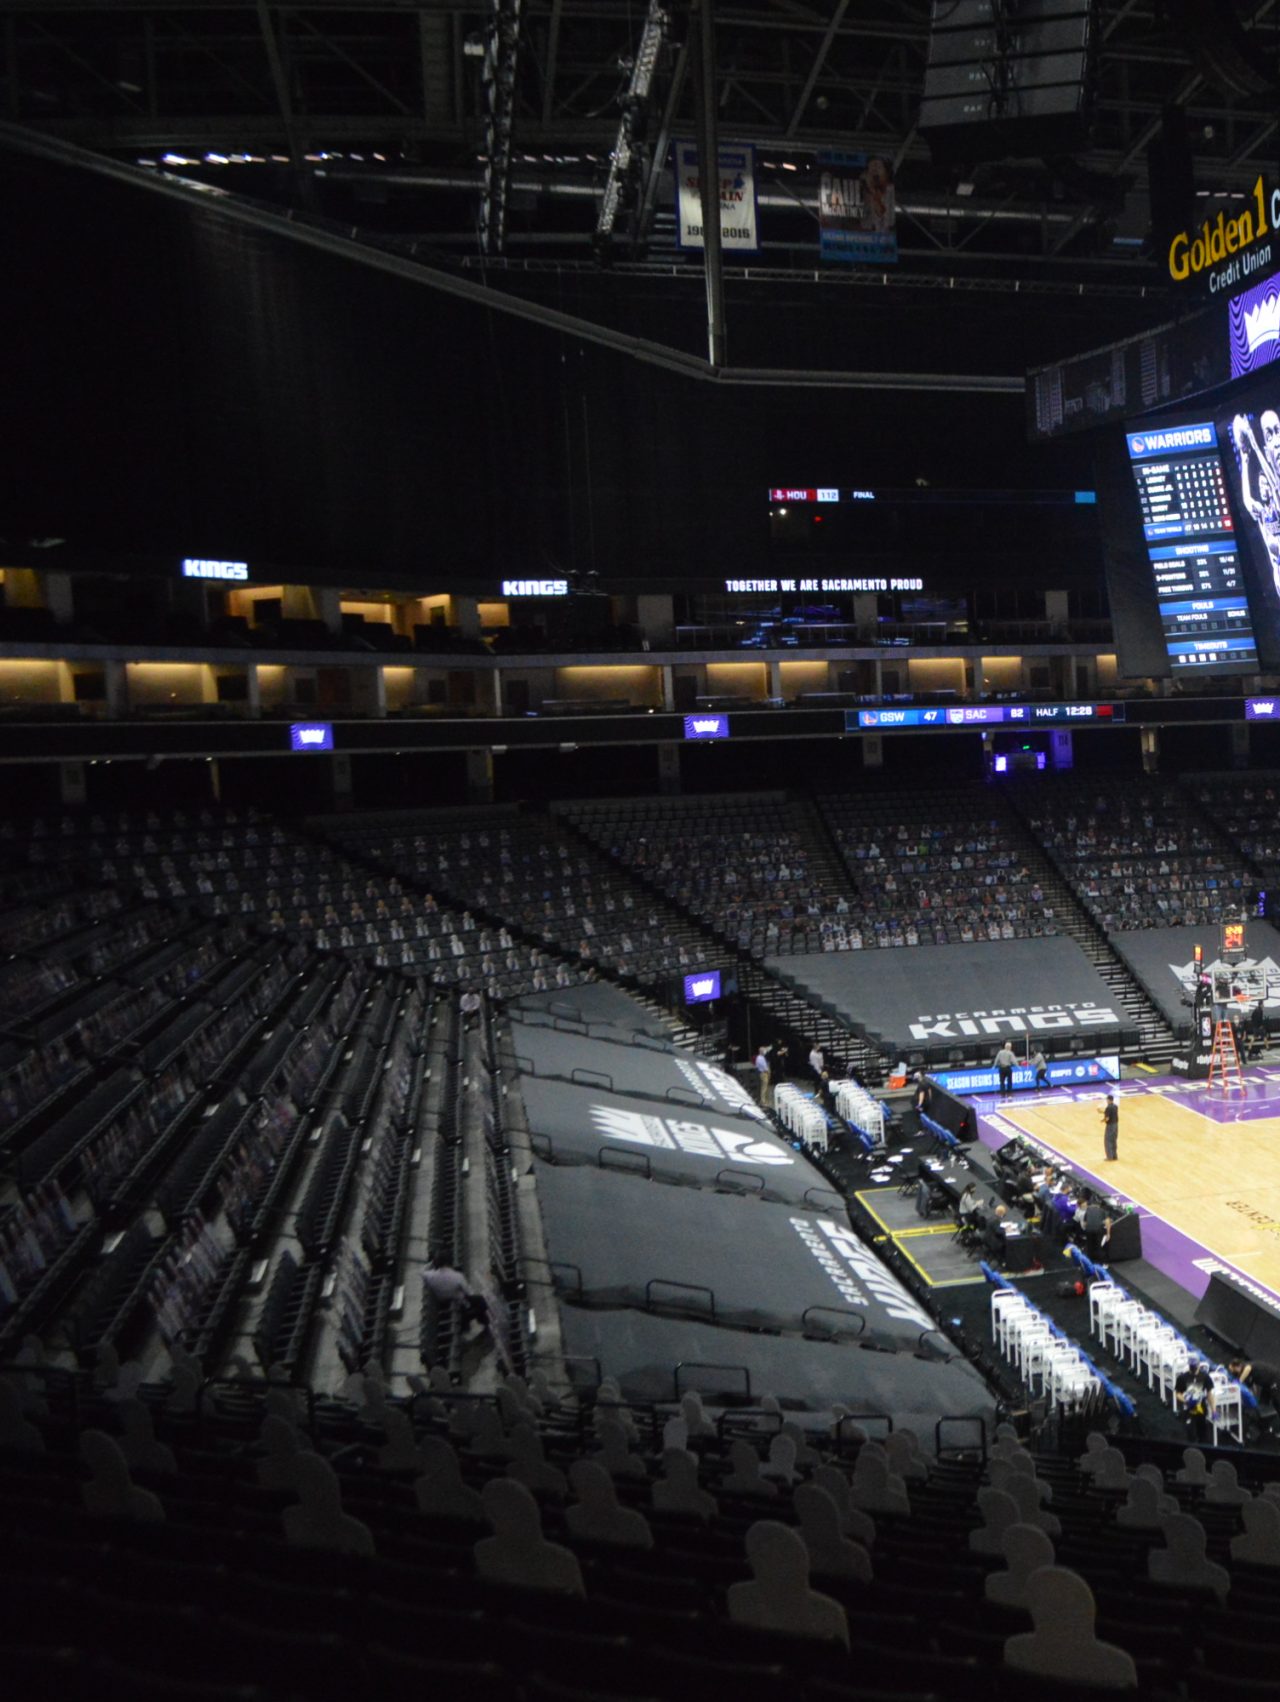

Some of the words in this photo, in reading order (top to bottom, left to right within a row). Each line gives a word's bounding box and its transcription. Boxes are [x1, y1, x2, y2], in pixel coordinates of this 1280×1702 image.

[1209, 259, 1241, 294] Credit
[1242, 245, 1272, 276] Union
[1144, 428, 1211, 450] WARRIORS
[787, 491, 807, 499] HOU
[853, 491, 875, 499] FINAL
[183, 558, 248, 580] KINGS
[502, 579, 569, 597] KINGS
[726, 580, 778, 592] TOGETHER
[781, 580, 797, 592] WE
[800, 579, 819, 591] ARE
[822, 579, 887, 591] SACRAMENTO
[890, 578, 923, 590] PROUD
[880, 712, 905, 722] GSW
[924, 711, 937, 721] 47
[966, 709, 987, 720] SAC
[1036, 708, 1058, 716] HALF
[918, 1002, 1097, 1022] SACRAMENTO
[909, 1008, 1120, 1039] KINGS
[946, 1075, 970, 1090] SEASON
[970, 1074, 993, 1088] BEGINS
